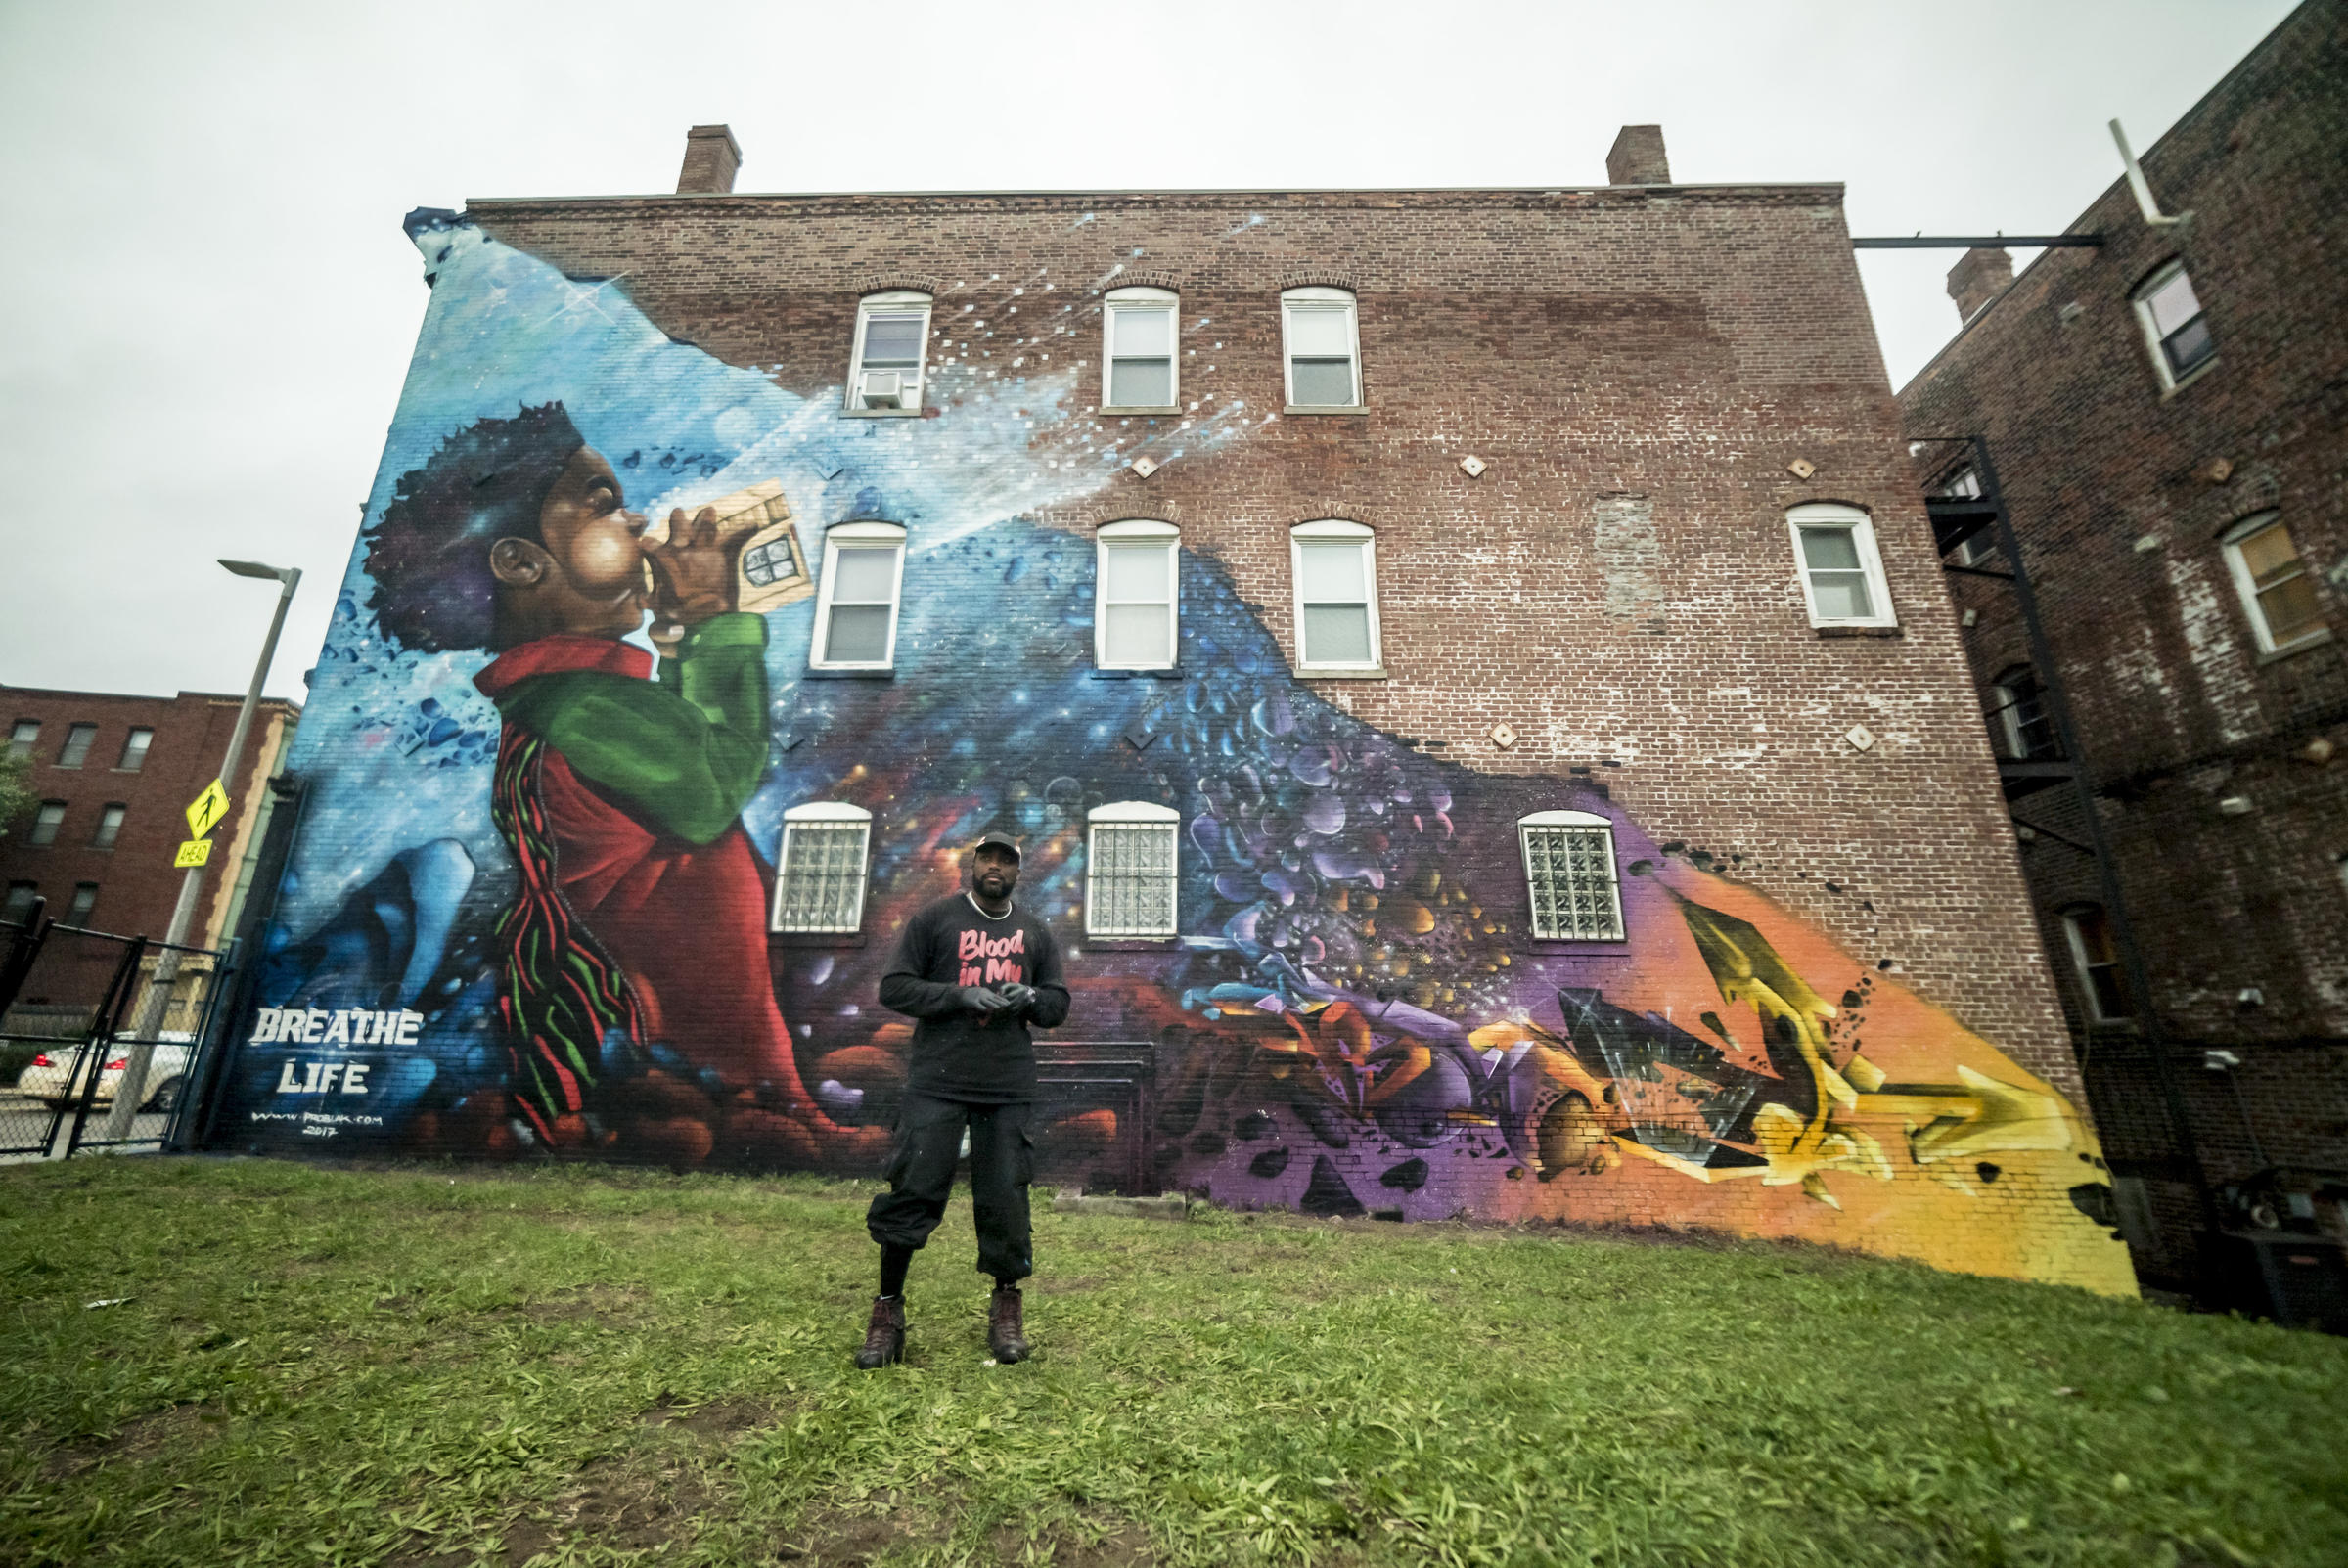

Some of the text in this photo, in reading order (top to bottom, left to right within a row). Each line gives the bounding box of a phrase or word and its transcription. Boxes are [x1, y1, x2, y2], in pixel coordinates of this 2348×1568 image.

[180, 844, 207, 862] AHEAD
[958, 929, 1024, 961] Blood
[959, 961, 982, 986] in
[248, 1005, 424, 1048] BREATHE
[276, 1058, 370, 1094] LIFE
[302, 1125, 339, 1138] 2017
